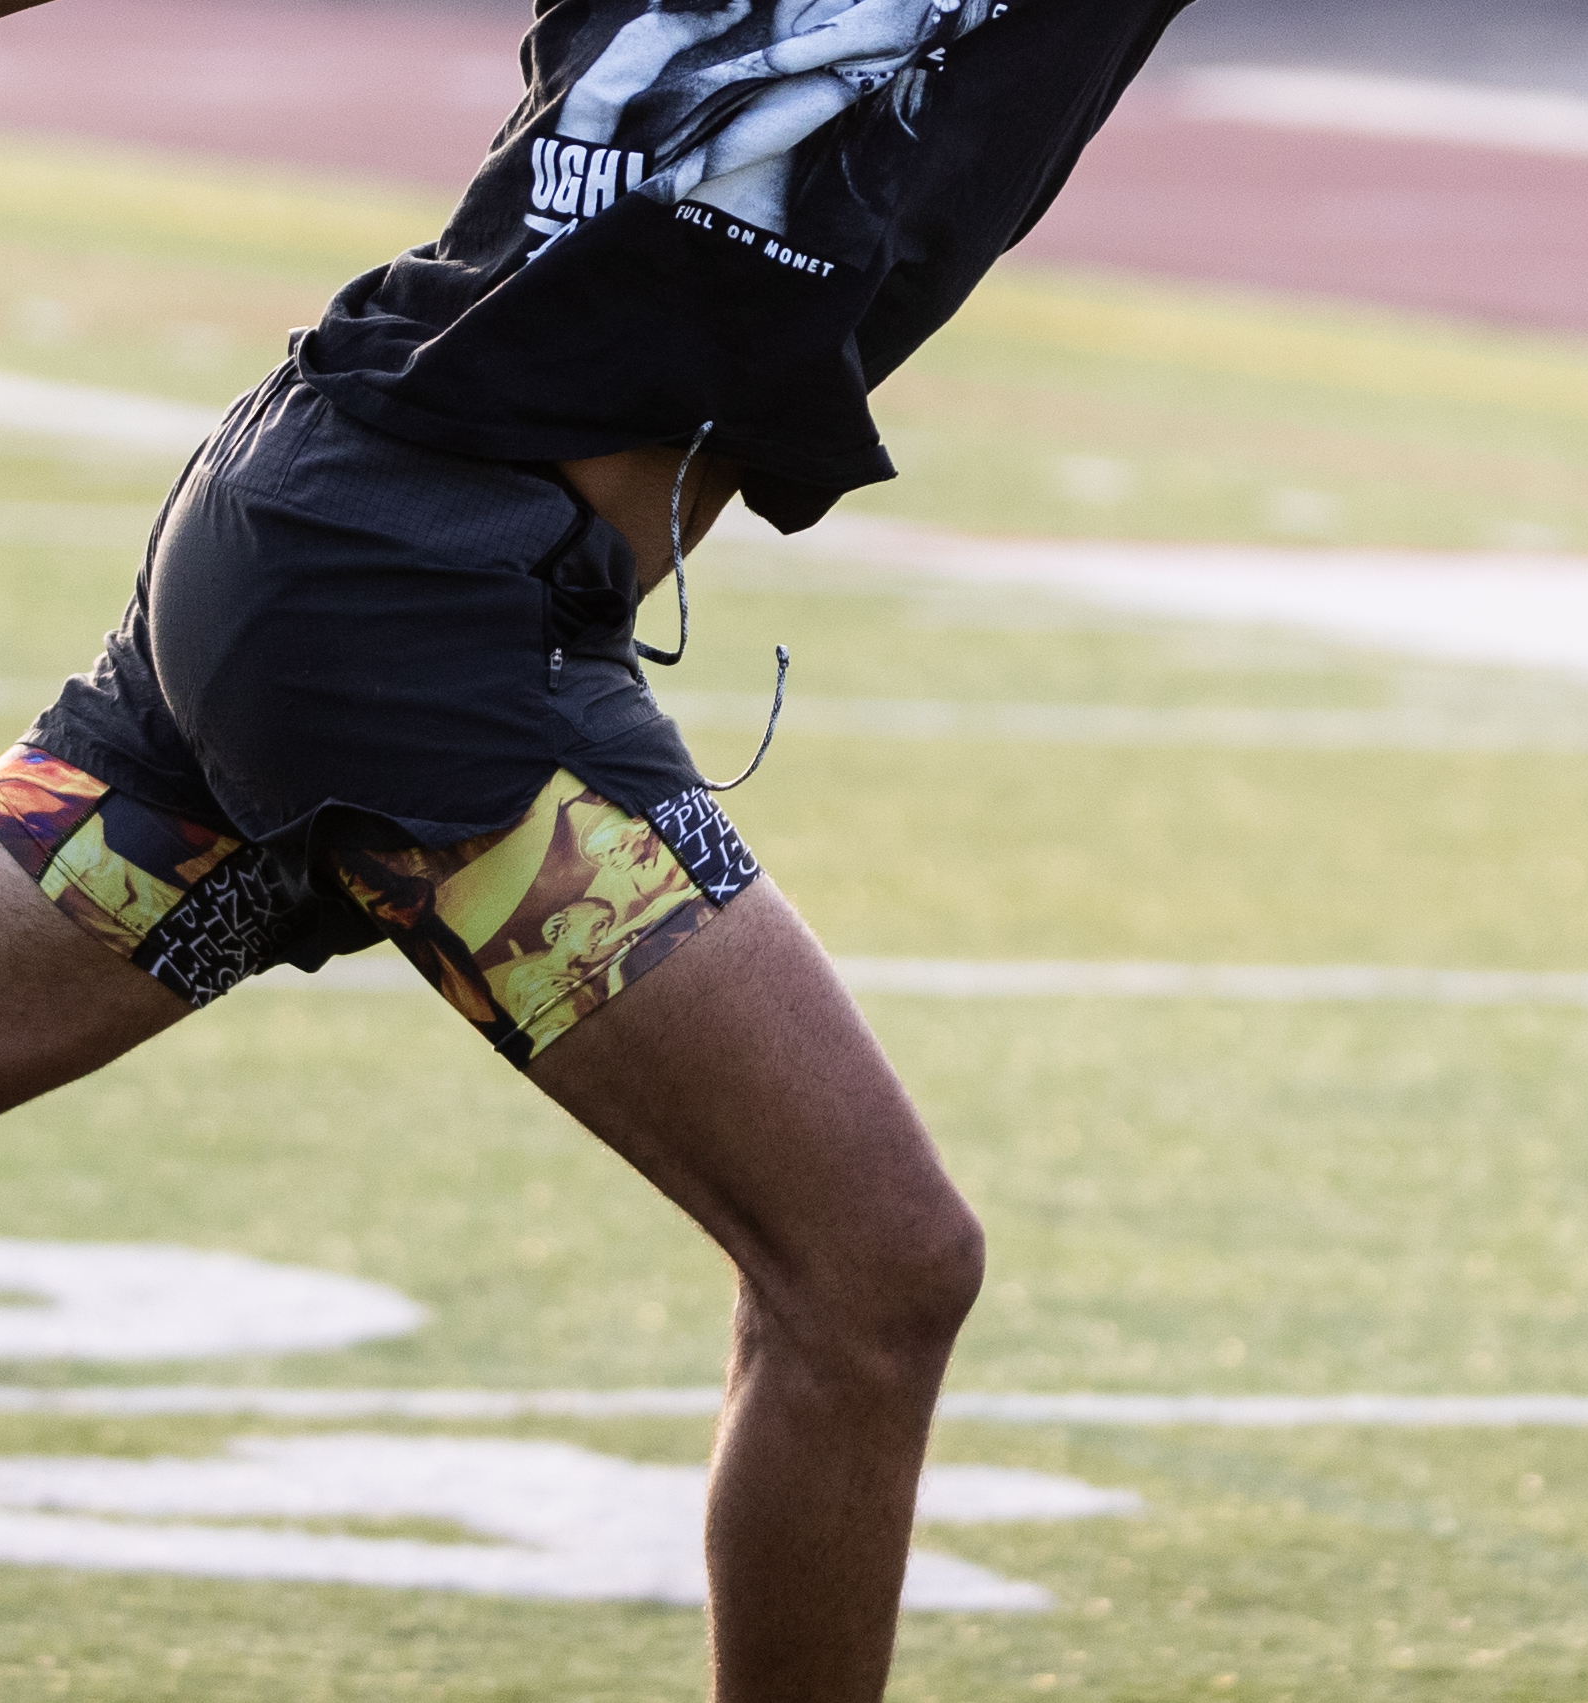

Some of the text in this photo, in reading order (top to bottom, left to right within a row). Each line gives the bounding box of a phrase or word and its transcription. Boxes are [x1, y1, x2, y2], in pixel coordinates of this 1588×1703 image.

[674, 204, 834, 277] FULL ON MONET
